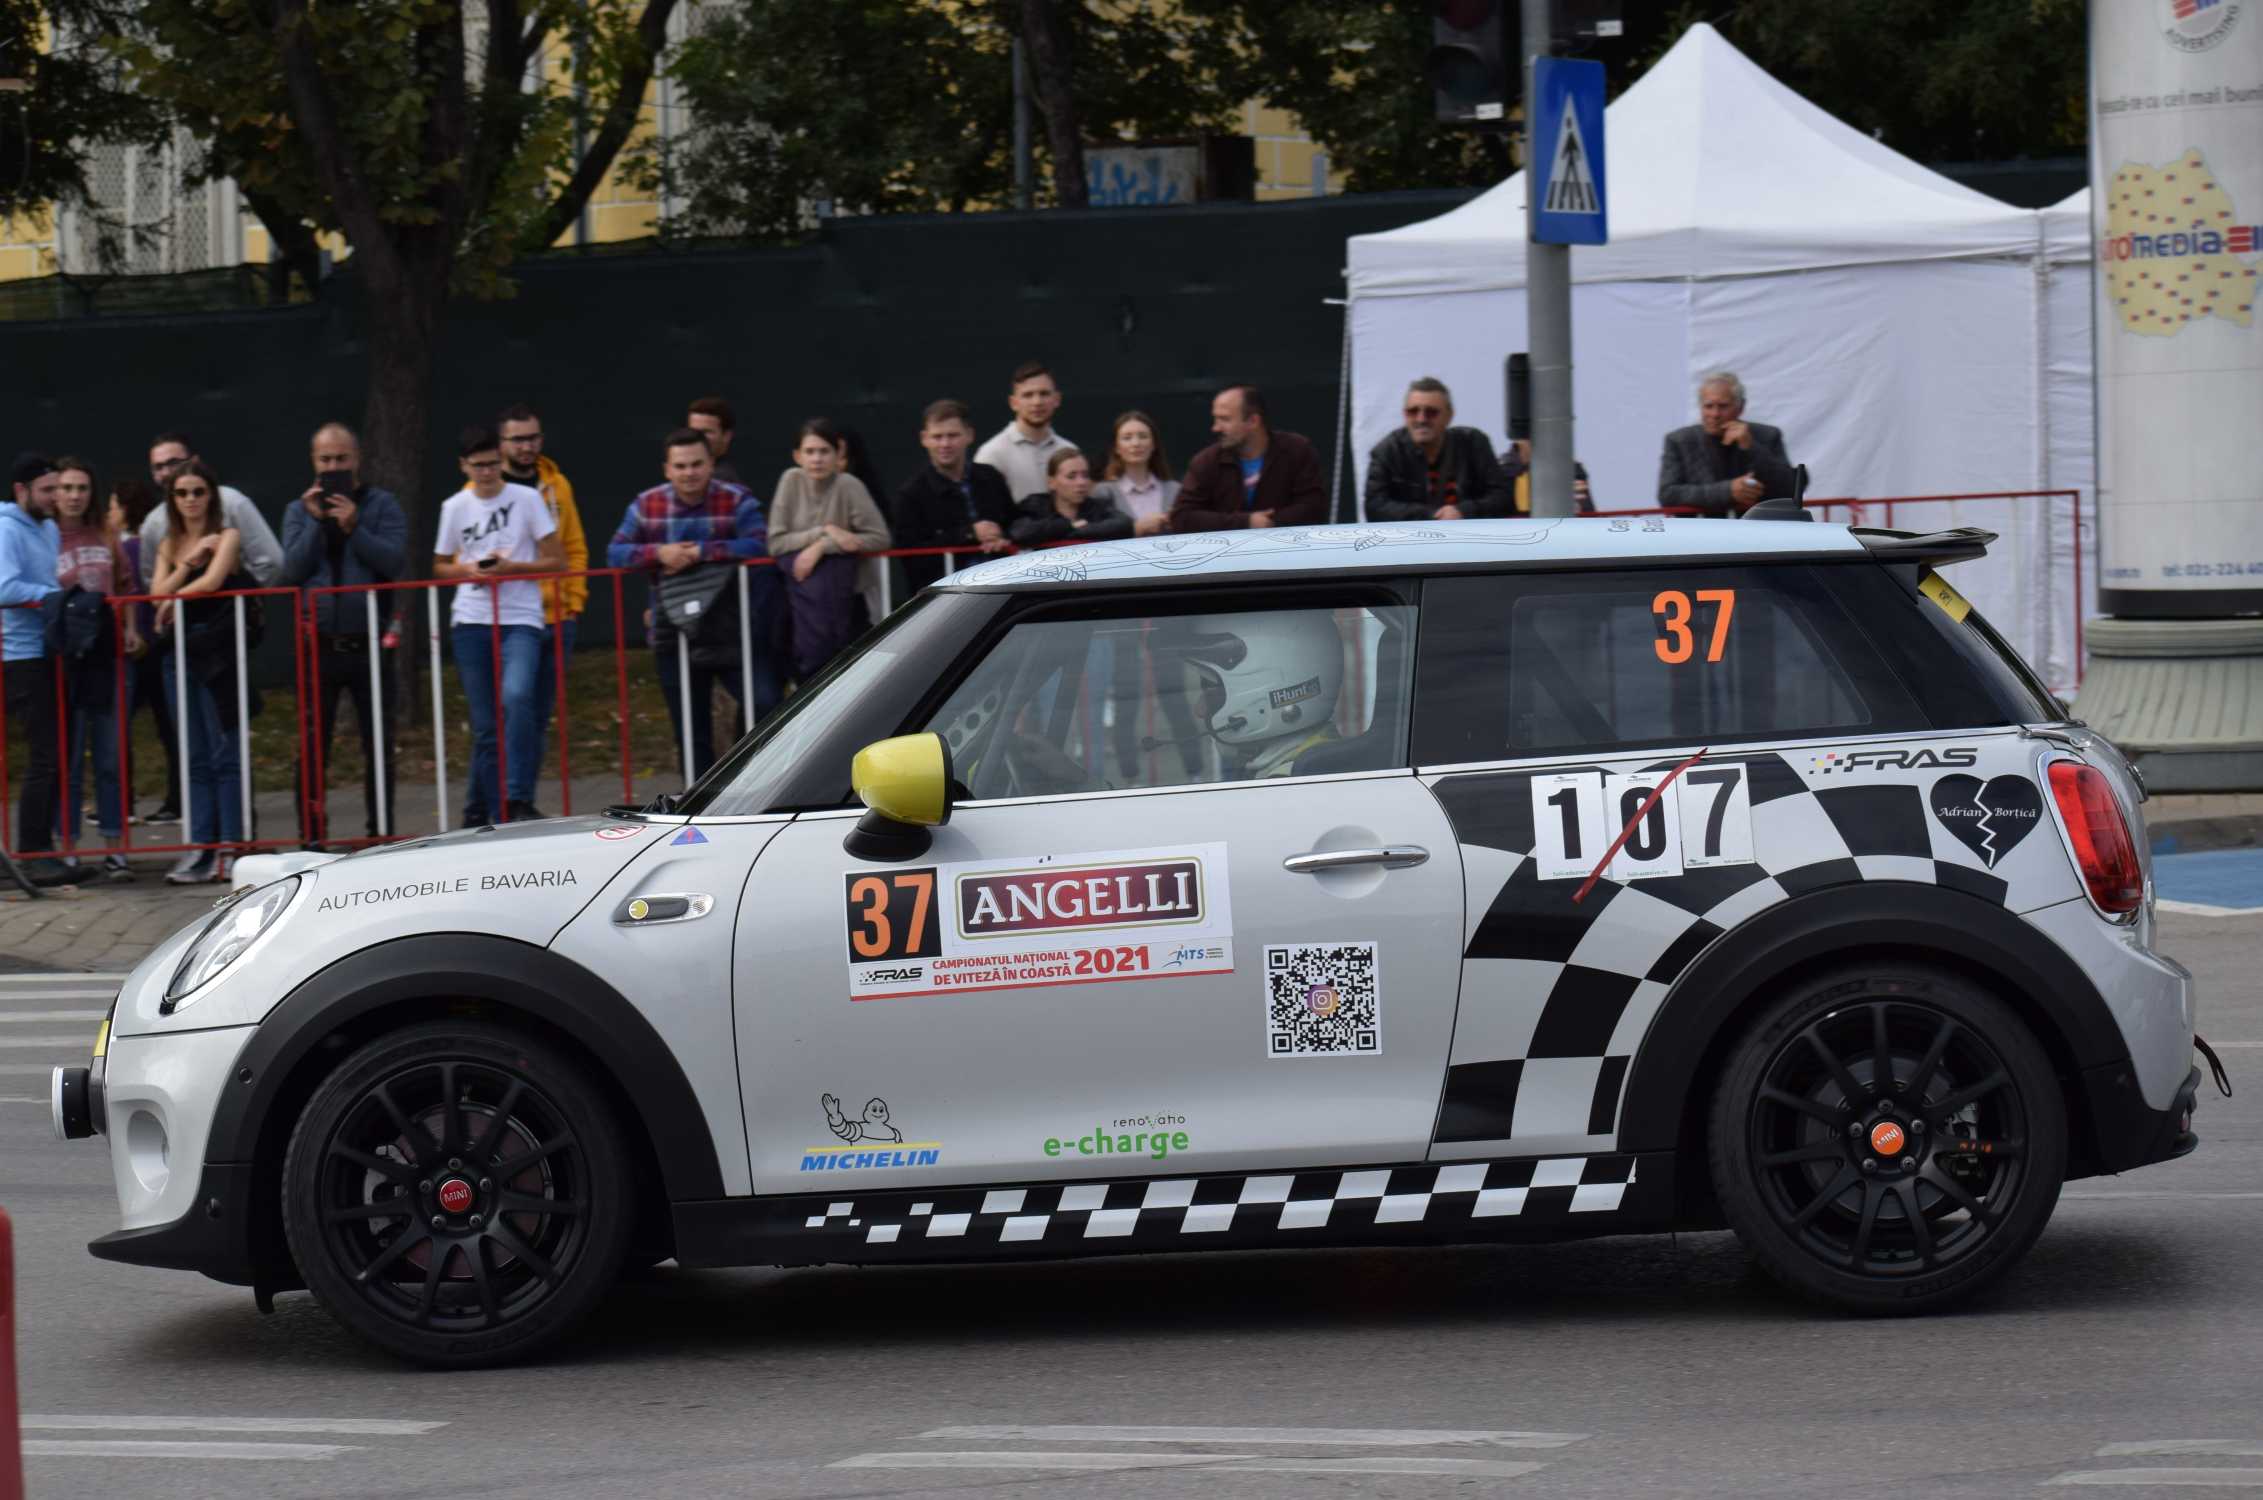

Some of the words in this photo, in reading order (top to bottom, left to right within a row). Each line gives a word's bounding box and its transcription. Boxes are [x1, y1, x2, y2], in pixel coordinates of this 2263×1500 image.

[463, 501, 514, 541] PLAY
[1652, 589, 1735, 664] 37
[1844, 747, 1978, 773] FRAS
[1937, 806, 1982, 817] Adrian
[1994, 806, 2037, 819] Borțică
[317, 877, 469, 913] AUTOMOBILE
[480, 869, 577, 890] BAVARIA
[850, 873, 934, 957] 37
[968, 871, 1193, 926] ANGELLI
[932, 955, 1012, 970] CAMPIONATUL
[1074, 945, 1150, 975] 2021
[1177, 949, 1205, 961] MTS
[872, 967, 923, 982] FRAS
[933, 975, 951, 986] DE
[954, 969, 1003, 984] VITEZĂ
[1003, 967, 1019, 980] ÎN
[1020, 964, 1071, 979] COASTĂ
[1043, 1128, 1189, 1160] e-charge
[800, 1150, 940, 1171] MICHELIN
[444, 1189, 468, 1203] MINI
